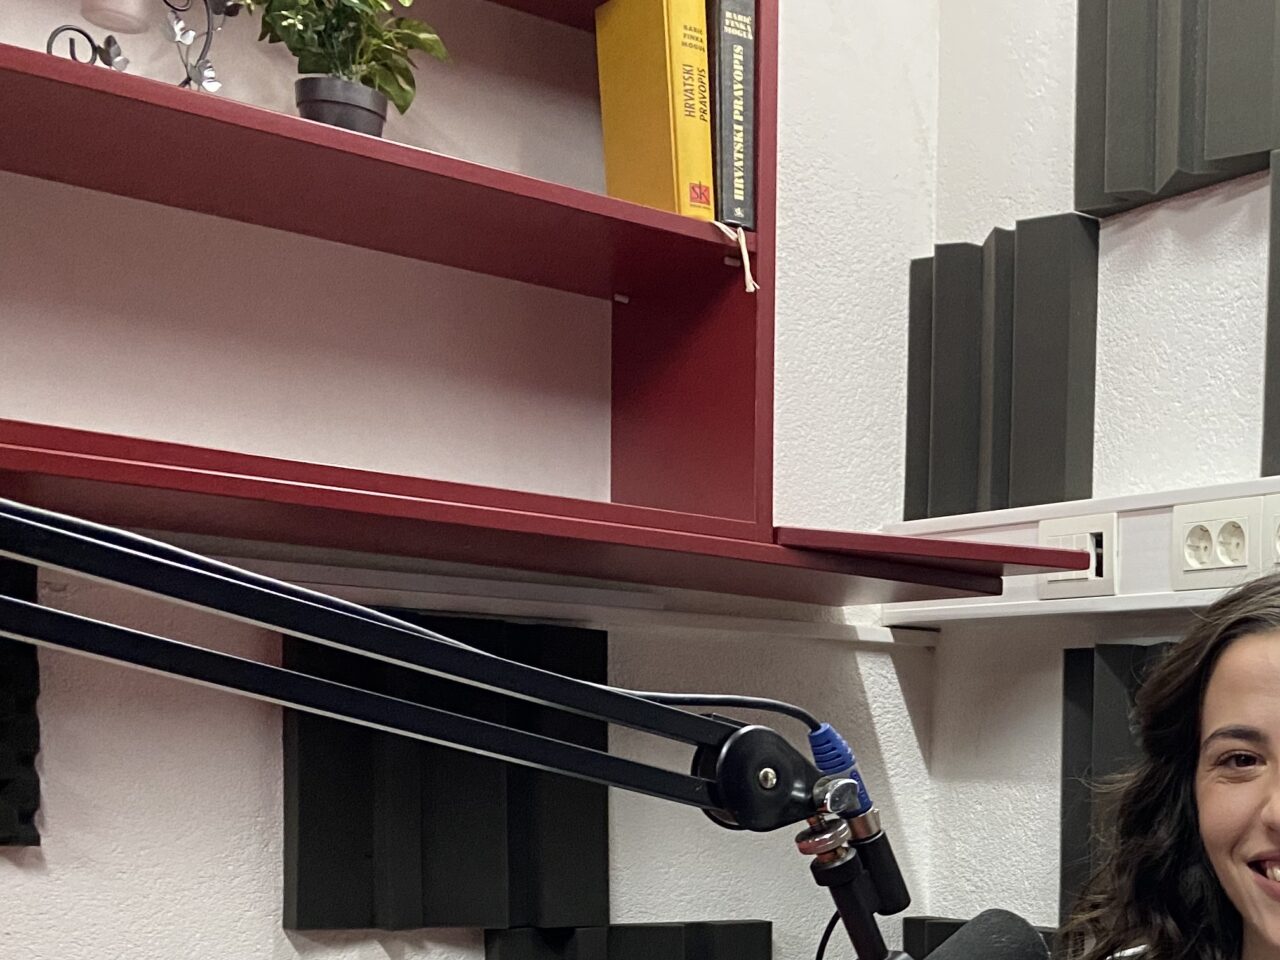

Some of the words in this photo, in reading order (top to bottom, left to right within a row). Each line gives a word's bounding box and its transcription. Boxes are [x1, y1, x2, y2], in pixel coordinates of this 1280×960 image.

[682, 64, 696, 118] HRVATSKI
[697, 68, 708, 122] PRAVOPIS
[733, 44, 744, 121] PRAVOPIS
[732, 124, 744, 201] HRVATSKI
